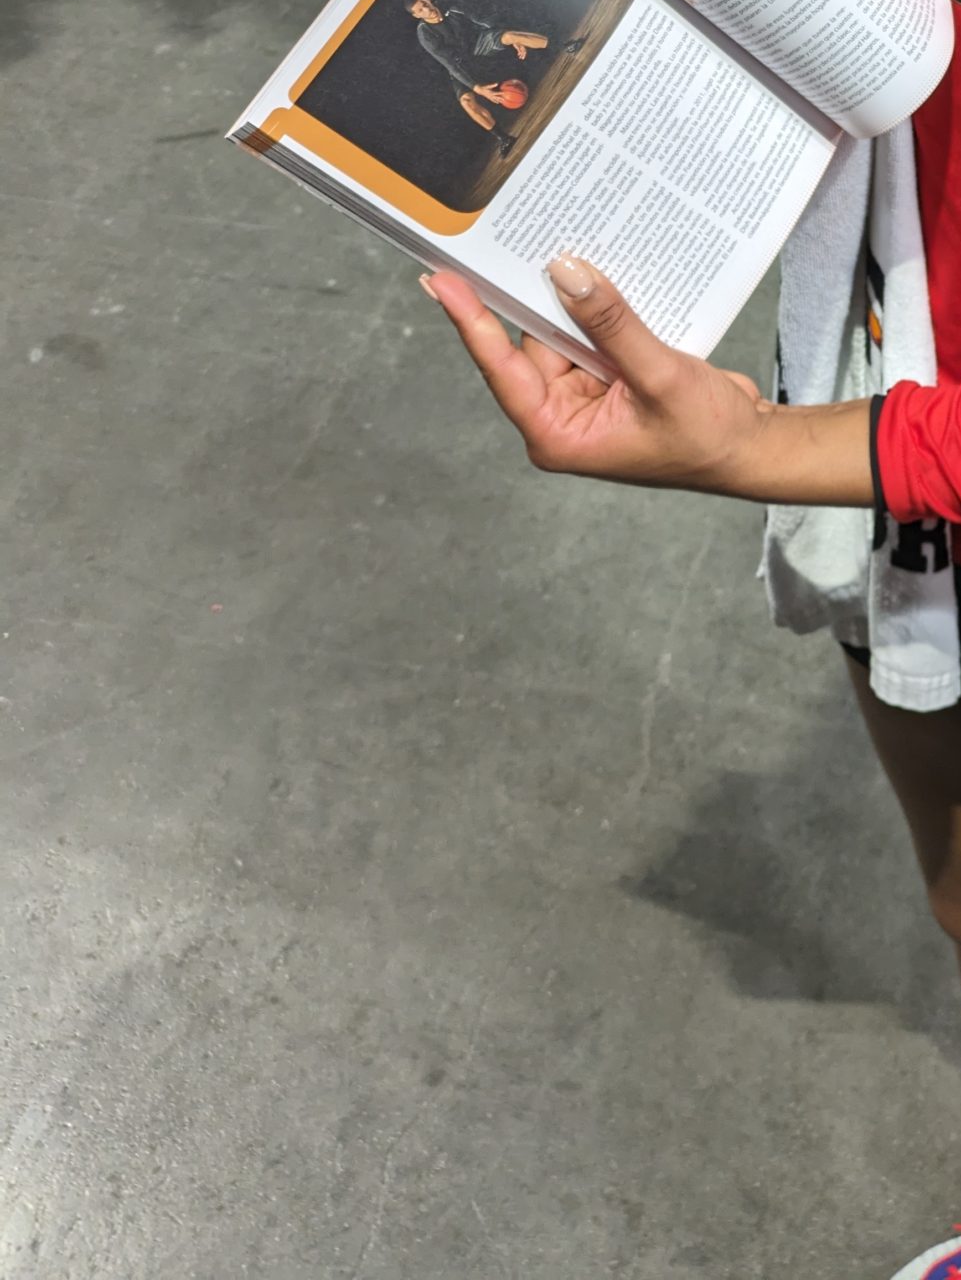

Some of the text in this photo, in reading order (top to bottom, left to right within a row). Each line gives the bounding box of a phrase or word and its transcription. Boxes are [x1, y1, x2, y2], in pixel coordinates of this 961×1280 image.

[492, 227, 505, 242] dale
[502, 206, 522, 230] Cooper
[538, 158, 558, 181] equipo
[561, 134, 574, 149] final
[571, 124, 581, 136] del
[500, 225, 518, 247] estado
[514, 188, 548, 228] consiguiendo
[547, 165, 565, 184] mejor
[560, 138, 583, 166] resultado
[548, 188, 558, 201] una
[555, 173, 569, 189] beca
[567, 160, 581, 176] para
[576, 144, 592, 162] jugar
[565, 211, 577, 224] dos
[525, 247, 538, 263] mera
